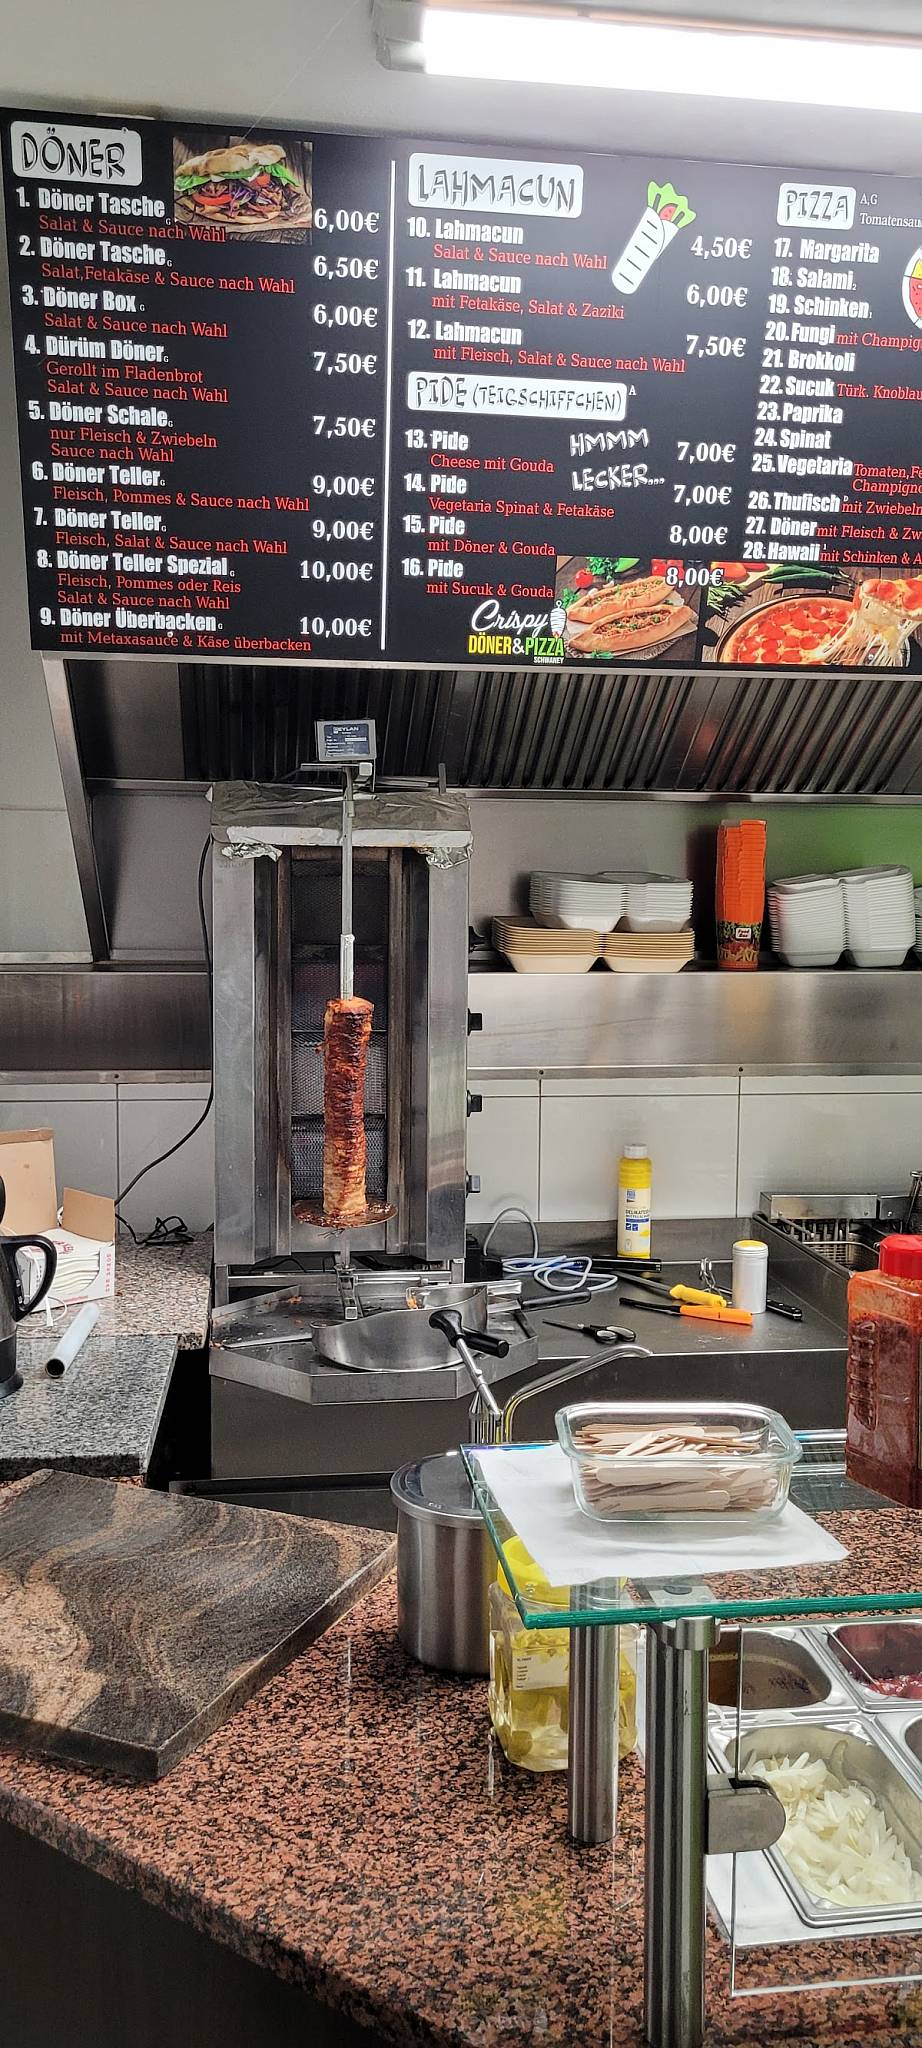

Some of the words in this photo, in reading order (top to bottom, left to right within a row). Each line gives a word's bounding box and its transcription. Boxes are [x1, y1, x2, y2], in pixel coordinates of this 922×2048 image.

[22, 127, 125, 179] DÖNER
[418, 164, 575, 213] LAHMACUN
[16, 186, 30, 207] 1.
[38, 187, 94, 213] Döner
[99, 193, 165, 218] Tasche
[785, 190, 848, 223] PIZZA
[39, 215, 78, 232] Salat
[99, 220, 144, 236] Sauce
[148, 224, 184, 240] nach
[188, 225, 226, 242] Wahl
[313, 208, 380, 234] 6,00€
[407, 217, 430, 238] 10.
[435, 218, 523, 245] Lahmacun
[19, 235, 36, 257] 2.
[40, 236, 96, 261] Döner
[100, 241, 166, 266] Tasche
[691, 235, 752, 260] 4,50€
[774, 237, 793, 258] 17.
[799, 238, 880, 263] Margarita
[313, 255, 379, 280] 6,50€
[771, 266, 792, 287] 18.
[797, 267, 853, 290] Salami
[170, 272, 214, 288] Sauce
[219, 276, 254, 291] nach
[259, 278, 295, 294] Wahl
[406, 266, 426, 287] 11.
[433, 268, 522, 294] Lahmacun
[22, 285, 39, 306] 3.
[43, 286, 98, 309] Döner
[102, 291, 136, 312] Box
[432, 294, 455, 308] mit
[459, 295, 523, 315] Fetakäse,
[528, 299, 564, 315] Salat
[582, 303, 624, 319] Zaziki
[687, 284, 748, 308] 6,00€
[768, 294, 790, 314] 19.
[794, 295, 869, 318] Schinken
[313, 304, 378, 328] 6,00€
[407, 319, 430, 340] 12.
[435, 320, 522, 345] Lahmacun
[764, 321, 789, 341] 20.
[791, 322, 835, 345] Fungi
[836, 332, 859, 345] mit
[861, 332, 922, 352] Champig
[24, 335, 41, 355] 4.
[46, 335, 106, 359] Dürüm
[110, 340, 164, 363] Döner
[686, 334, 746, 358] 7,50€
[313, 352, 377, 375] 7,50€
[433, 346, 456, 360] mit
[461, 347, 513, 366] Fleisch,
[518, 350, 553, 365] Salat
[571, 353, 612, 369] Sauce
[616, 357, 648, 371] nach
[652, 357, 686, 373] Wahl
[762, 348, 783, 368] 21.
[788, 349, 855, 372] Brokkoli
[46, 361, 97, 377] Gerollt
[101, 364, 120, 378] im
[124, 366, 204, 383] Fladenbrot
[416, 377, 467, 408] PIDE
[472, 383, 622, 415] (TEIGSCHIFFCHEN)
[759, 375, 783, 395] 22.
[785, 376, 835, 397] Sucuk
[837, 383, 869, 398] Türk.
[28, 400, 45, 420] 5.
[49, 401, 102, 423] Döner
[107, 404, 168, 428] Schale
[756, 401, 781, 421] 23.
[783, 402, 843, 424] Paprika
[50, 428, 76, 441] nur
[80, 427, 131, 443] Fleisch
[151, 431, 218, 448] Zwiebeln
[313, 416, 376, 439] 7,50€
[754, 428, 777, 447] 24.
[780, 429, 831, 450] Spinat
[404, 429, 427, 448] 13.
[432, 430, 469, 451] Pide
[569, 428, 649, 456] HMMM
[430, 454, 480, 469] Cheese
[484, 457, 506, 470] mit
[509, 458, 554, 473] Gouda
[677, 441, 736, 464] 7,00€
[31, 461, 48, 481] 6.
[52, 462, 105, 483] Döner
[109, 465, 160, 487] Teller
[751, 454, 775, 472] 25.
[777, 454, 853, 476] Vegetaria
[312, 475, 375, 497] 9,00€
[403, 473, 426, 492] 14.
[430, 474, 467, 494] Pide
[673, 484, 732, 506] 7,00€
[429, 497, 492, 514] Vegetaria
[496, 500, 539, 516] Spinat
[556, 503, 615, 518] Fetakäse
[748, 491, 771, 510] 26.
[774, 491, 840, 513] Thufisch
[841, 501, 863, 513] mit
[866, 501, 922, 516] Zwiebeln
[33, 507, 48, 526] 7.
[54, 508, 107, 528] Döner
[111, 510, 161, 532] Teller
[312, 519, 374, 542] 9,00€
[402, 515, 425, 533] 15.
[429, 516, 465, 535] Pide
[745, 516, 766, 535] 27.
[771, 517, 818, 537] Döner
[841, 525, 885, 539] Fleisch
[454, 539, 495, 553] Döner
[512, 541, 555, 556] Gouda
[669, 525, 728, 546] 8,00€
[36, 549, 53, 568] 8.
[57, 550, 109, 570] Döner
[113, 553, 163, 573] Teller
[167, 555, 228, 576] Spezial
[742, 541, 766, 559] 28.
[767, 542, 820, 562] Hawaii
[843, 549, 898, 564] Schinken
[300, 560, 373, 583] 10,00€
[402, 558, 424, 576] 16.
[427, 559, 464, 577] Pide
[665, 567, 724, 588] 8,00€
[57, 573, 112, 590] Fleisch,
[116, 576, 173, 591] Pommes
[177, 579, 208, 592] oder
[213, 579, 241, 593] Reis
[452, 582, 493, 596] Sucuk
[511, 584, 554, 598] Gouda
[40, 607, 56, 626] 9.
[59, 608, 111, 628] Döner
[115, 607, 217, 631] Überbacken
[299, 617, 372, 638] 10,00€
[471, 599, 548, 637] Crispy
[61, 631, 83, 644] mit
[87, 632, 179, 646] Metaxasauce
[197, 635, 230, 649] Käse
[234, 637, 311, 651] überbacken
